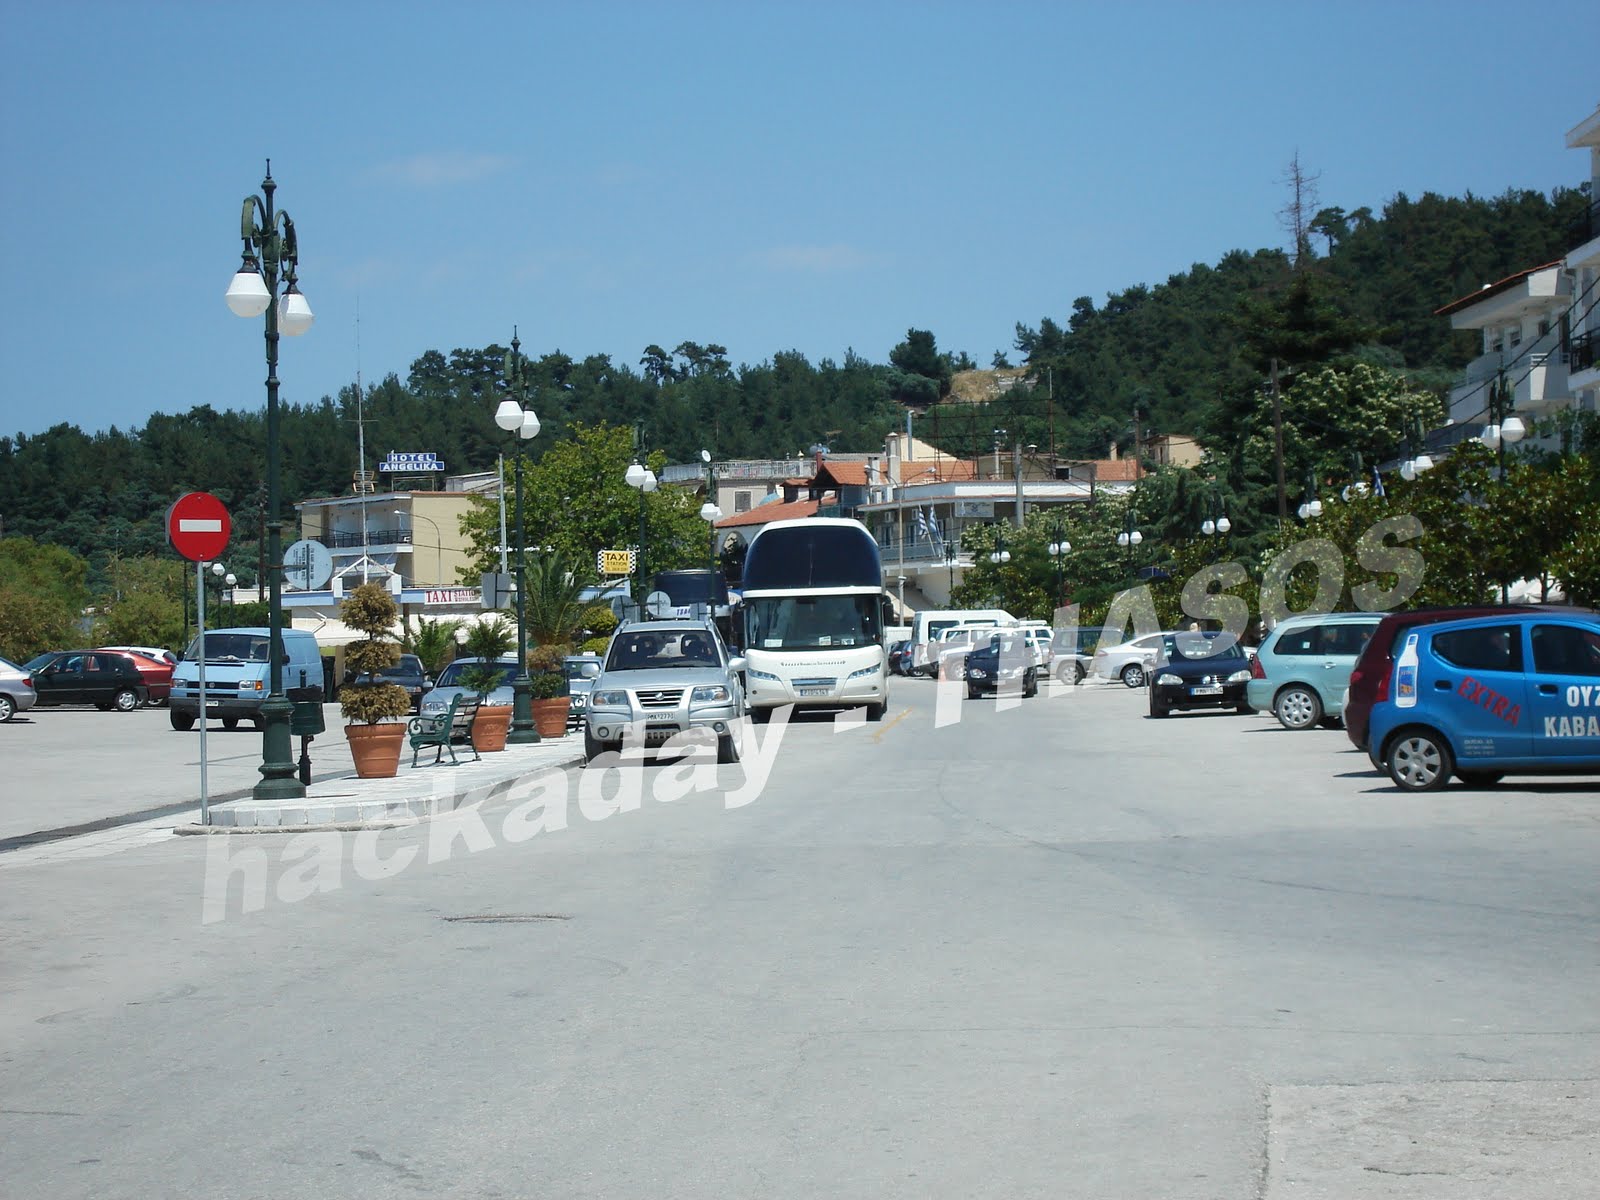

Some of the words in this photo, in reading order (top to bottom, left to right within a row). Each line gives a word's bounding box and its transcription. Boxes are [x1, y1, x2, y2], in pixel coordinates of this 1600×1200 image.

[383, 463, 439, 471] ANGELIKA
[605, 553, 629, 561] TAXI
[426, 590, 452, 603] TAXI
[1457, 675, 1521, 728] EXTRA
